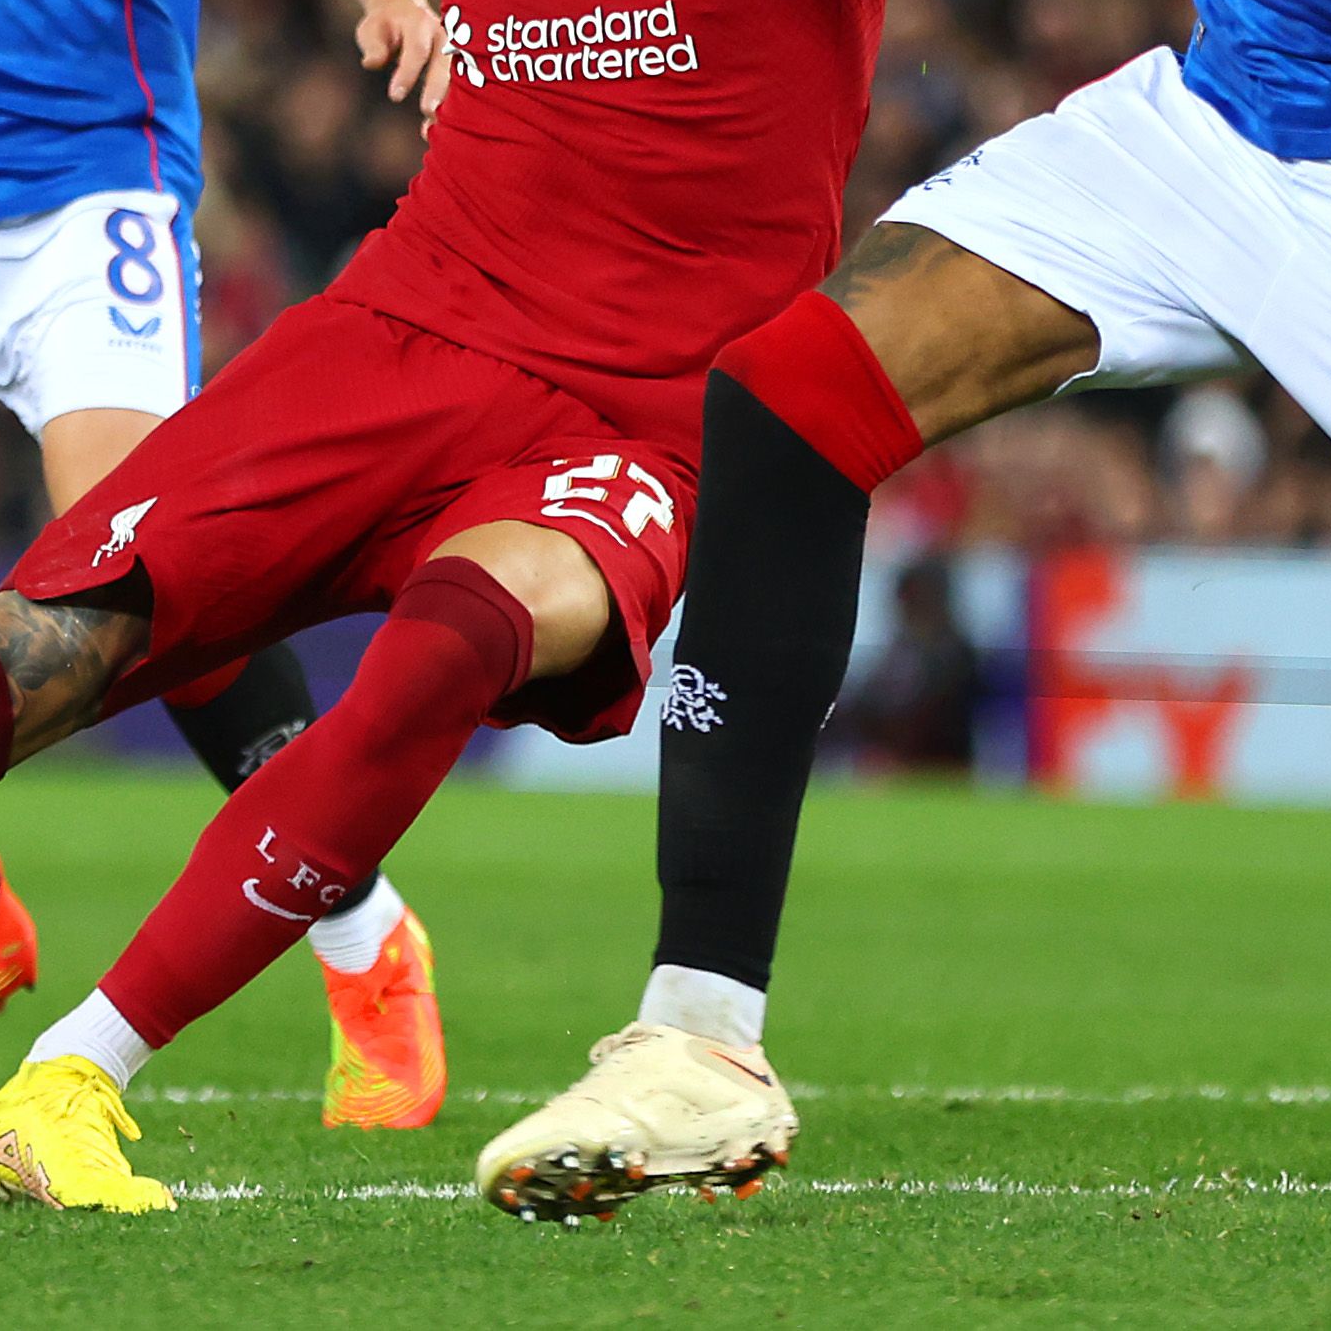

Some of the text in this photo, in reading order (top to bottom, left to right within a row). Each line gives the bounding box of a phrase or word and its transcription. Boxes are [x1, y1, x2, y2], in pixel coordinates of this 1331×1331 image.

[487, 0, 677, 52] standard
[491, 35, 698, 82] chartered
[105, 208, 163, 305] 8
